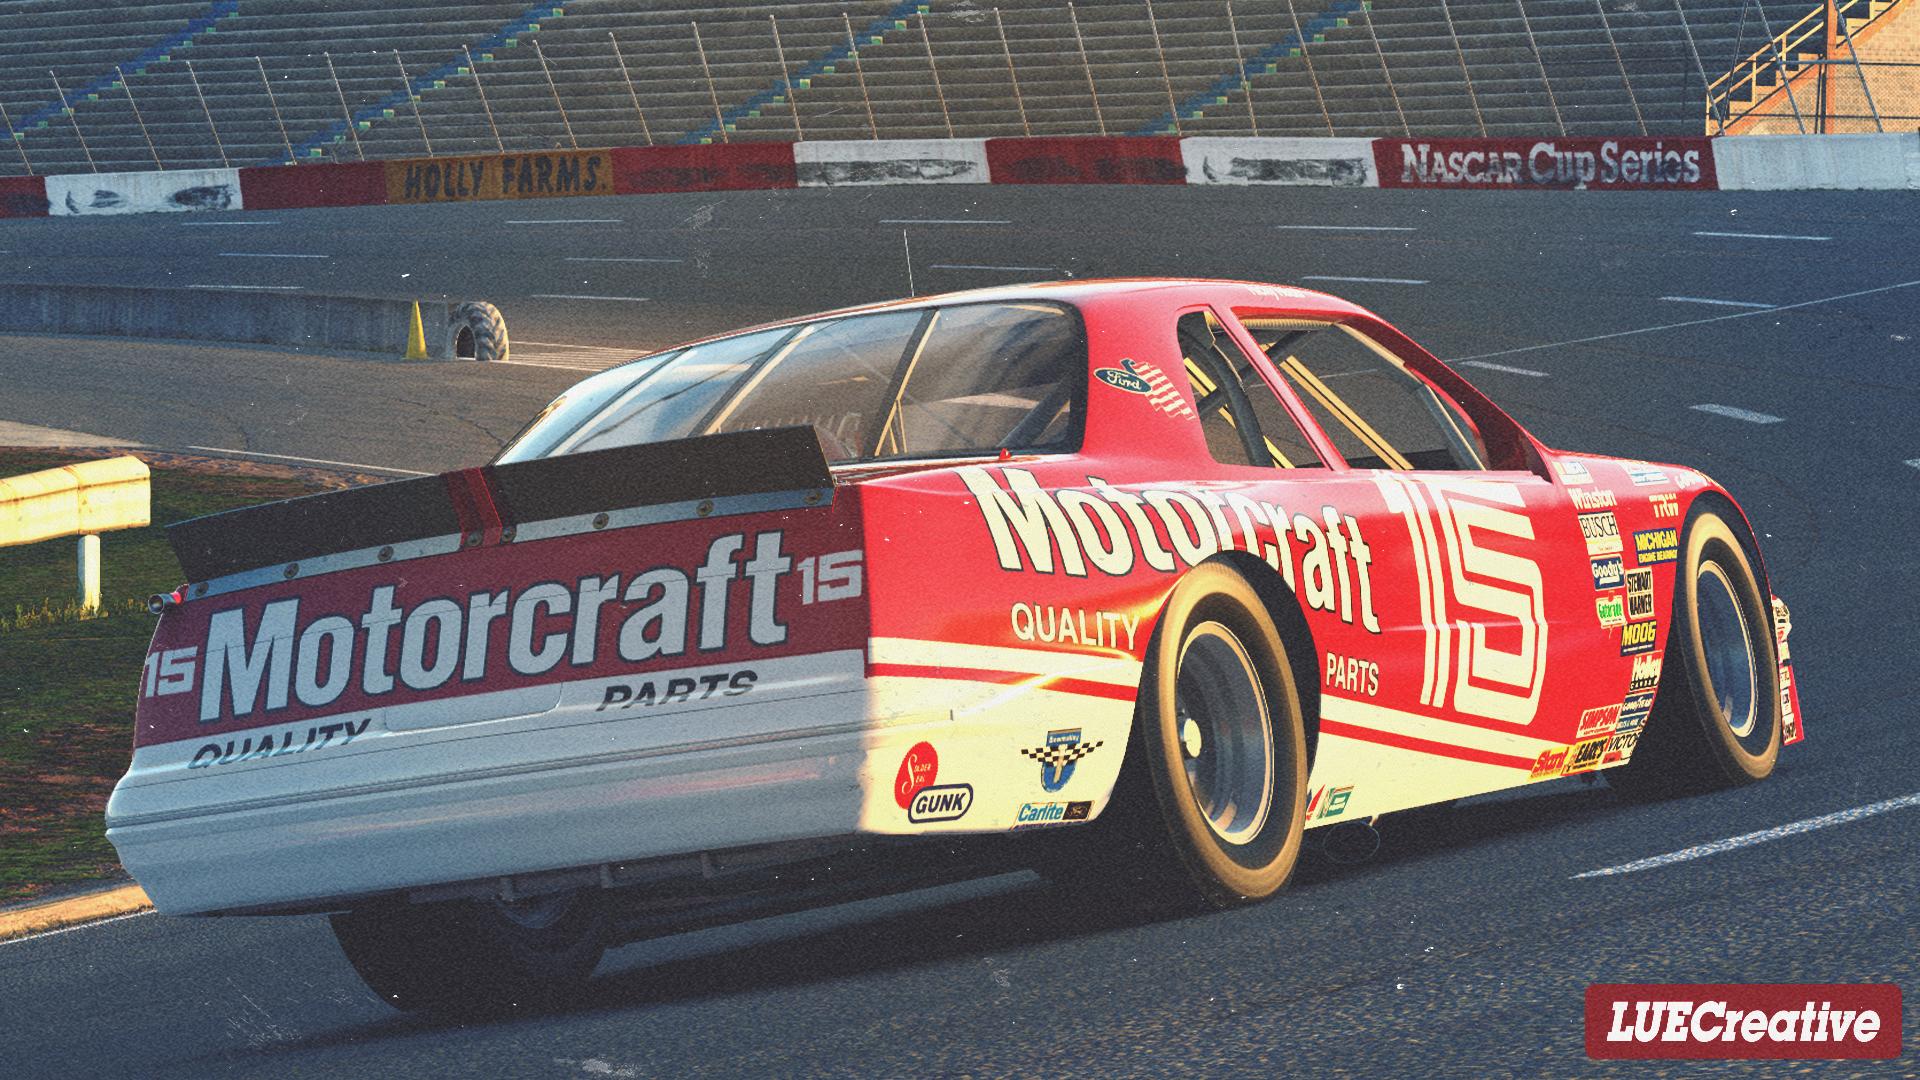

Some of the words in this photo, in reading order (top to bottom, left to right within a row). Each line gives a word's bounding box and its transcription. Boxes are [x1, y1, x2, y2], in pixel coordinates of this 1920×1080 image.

[1528, 141, 1595, 190] Cup
[1600, 140, 1700, 184] Series
[405, 162, 482, 198] HOLLY
[1107, 370, 1142, 391] Ford
[1567, 486, 1618, 510] Winston
[1649, 493, 1679, 518] TRW
[1579, 514, 1619, 539] BUSCH
[954, 466, 1382, 634] Motorcraft
[1635, 529, 1678, 551] MICHIGAN
[1592, 561, 1624, 578] Goody's
[1627, 571, 1652, 593] STEWART
[1371, 469, 1549, 726] 15
[1629, 594, 1653, 616] WARNER
[145, 645, 198, 698] 15
[197, 529, 791, 725] Motorcraft
[797, 549, 863, 606] 15
[1010, 602, 1141, 650] QUALITY
[1325, 652, 1379, 697] PARTS
[1632, 655, 1662, 686] Holley
[596, 669, 758, 711] PARTS
[1579, 705, 1622, 731] SIMPSON
[187, 717, 372, 770] QUALITY
[915, 792, 967, 814] GUNK
[1018, 802, 1063, 822] Carlite
